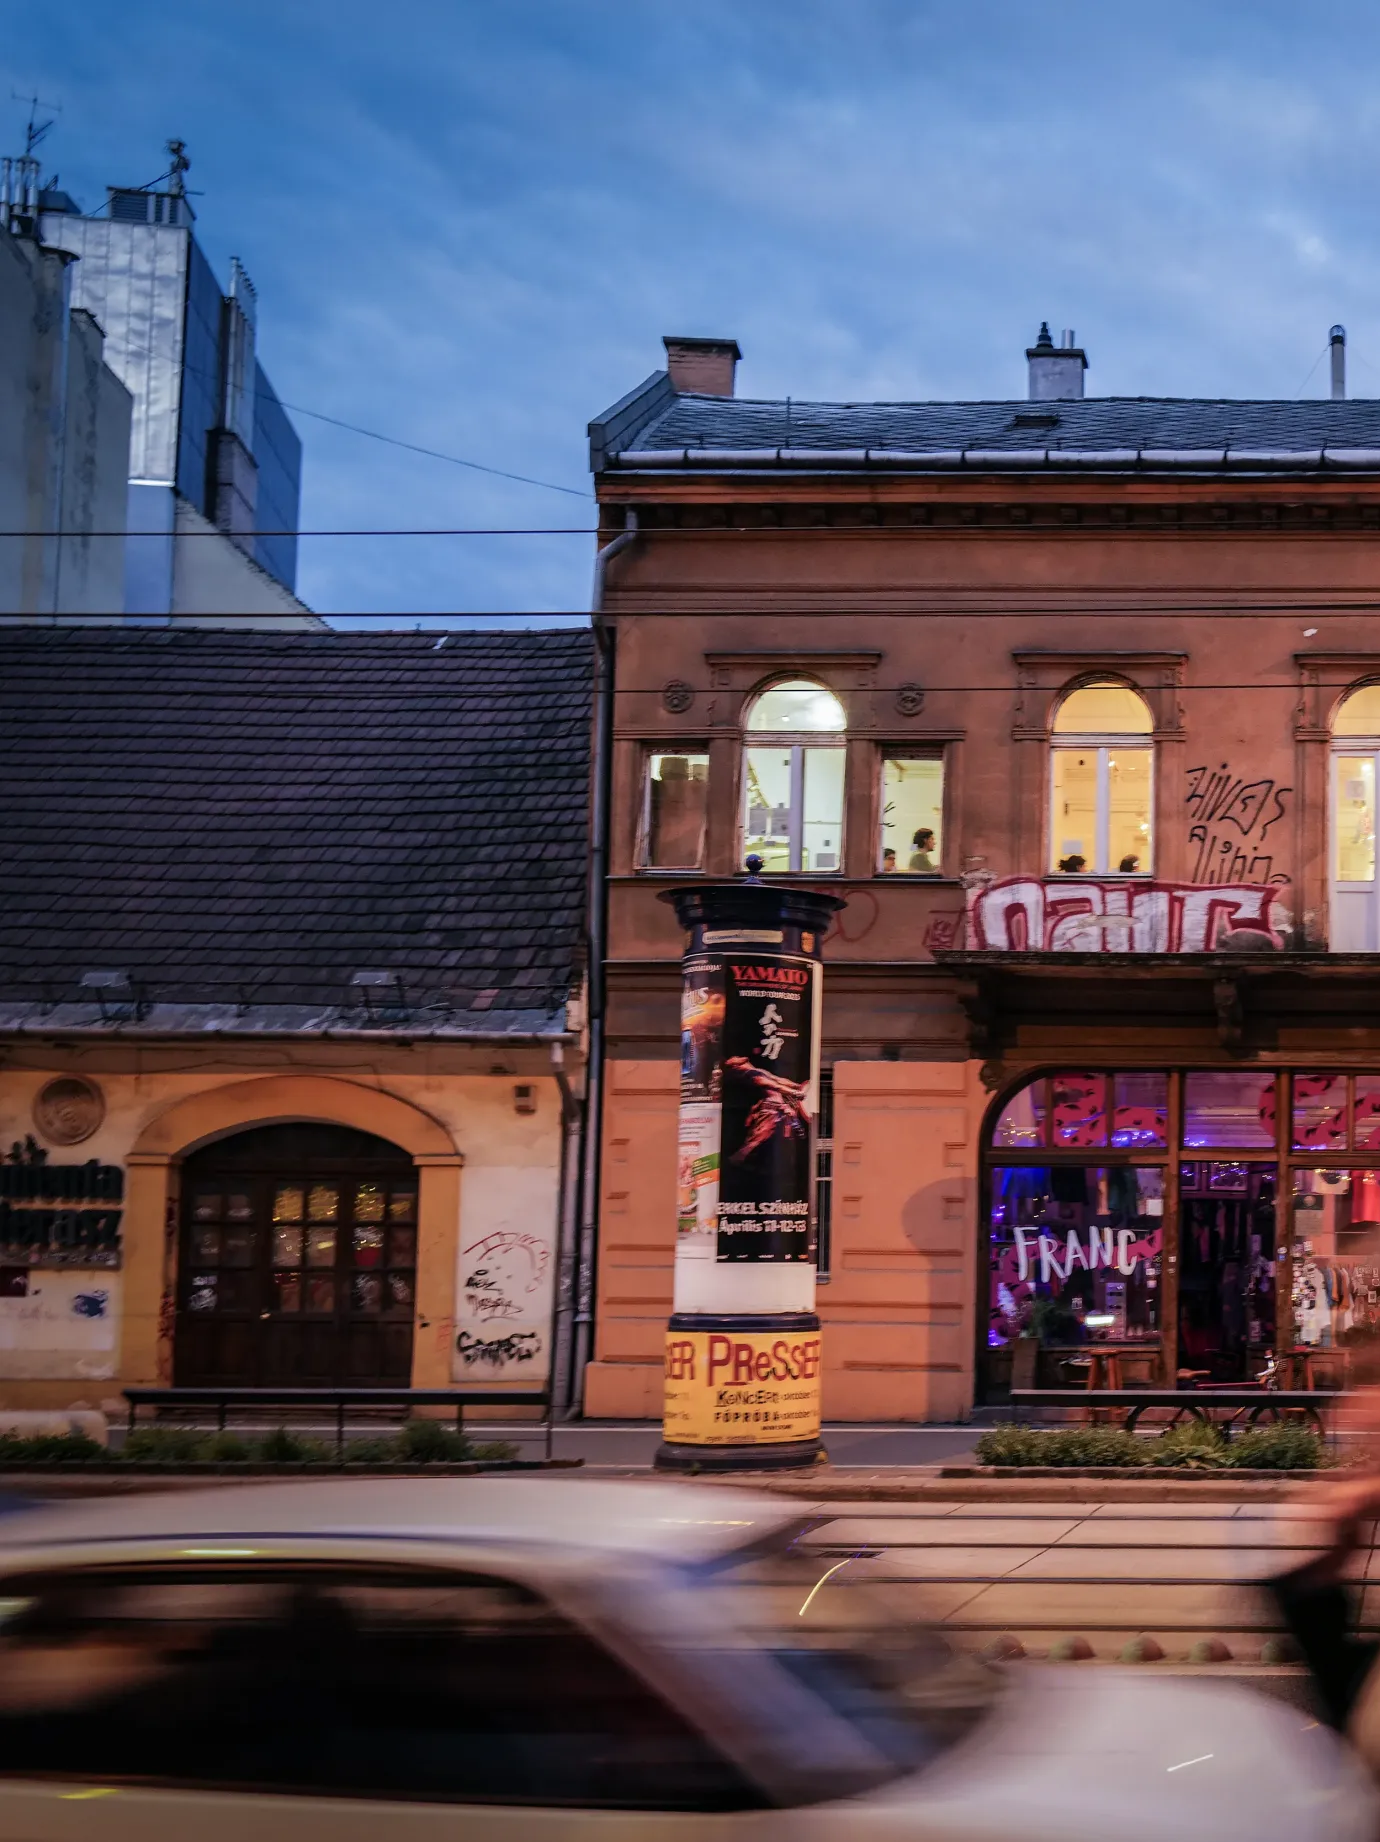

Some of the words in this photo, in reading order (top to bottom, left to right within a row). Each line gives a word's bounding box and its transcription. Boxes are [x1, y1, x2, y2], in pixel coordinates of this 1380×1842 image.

[730, 965, 808, 985] YAMATO
[717, 1202, 758, 1215] ERKEL
[718, 1216, 763, 1235] Április
[1013, 1225, 1138, 1283] FRANC
